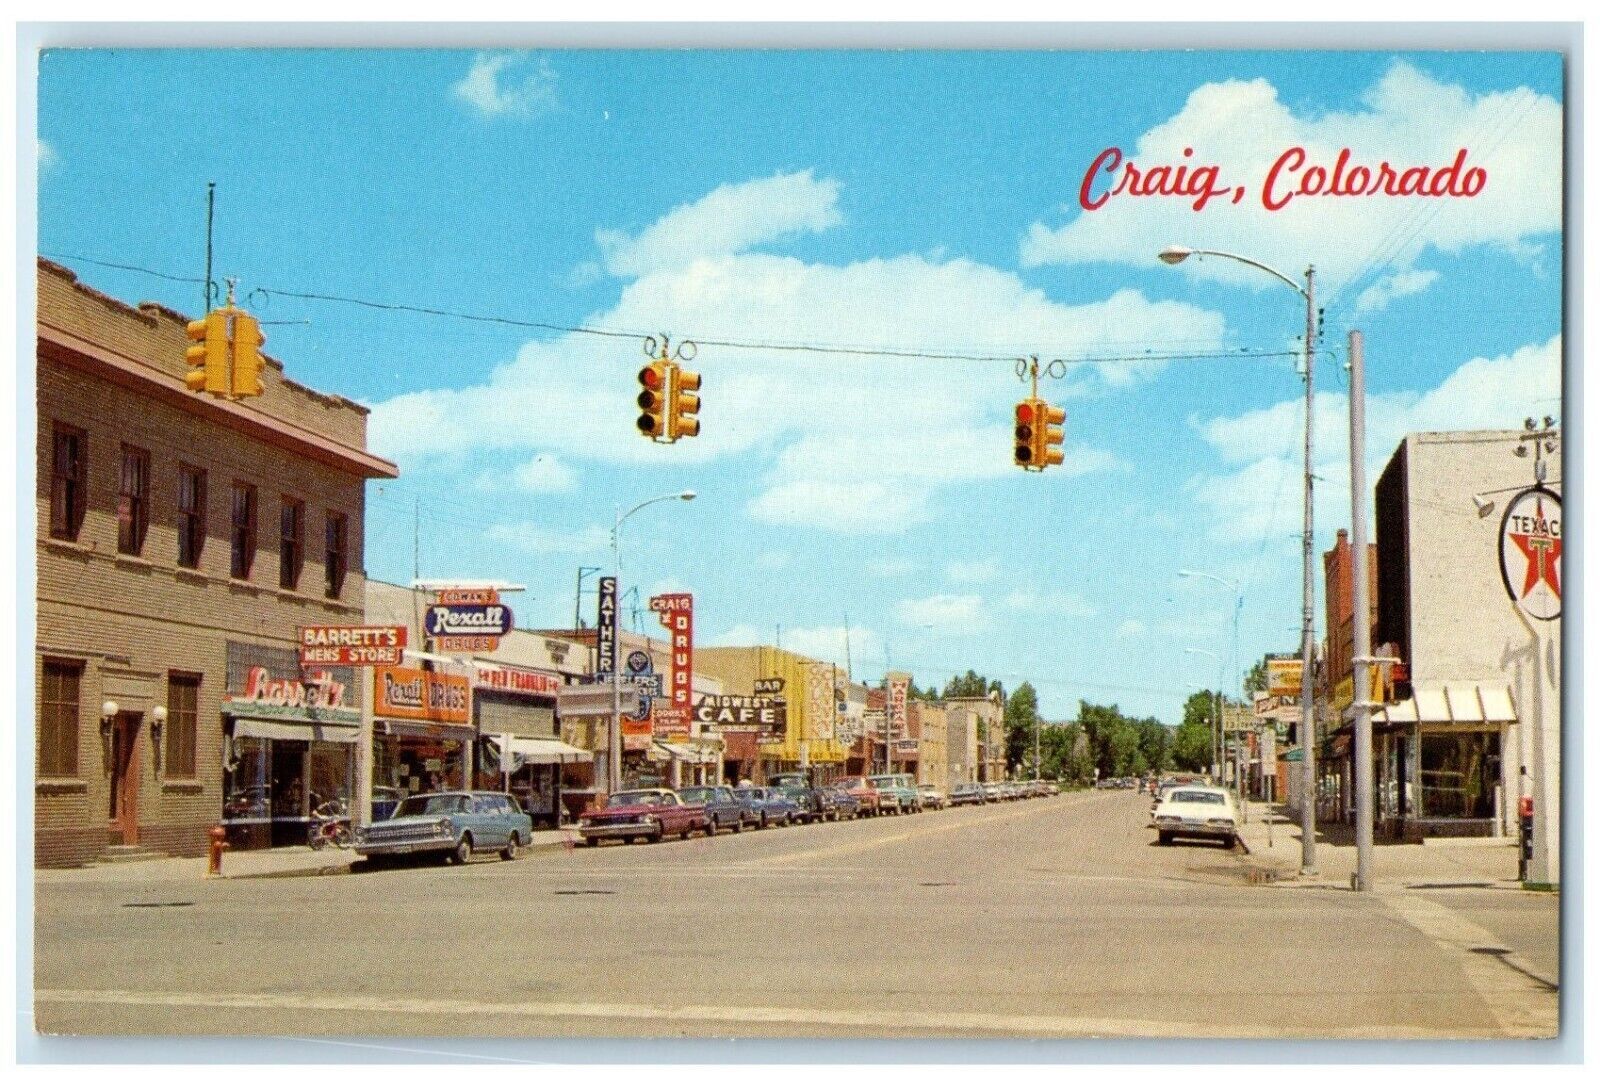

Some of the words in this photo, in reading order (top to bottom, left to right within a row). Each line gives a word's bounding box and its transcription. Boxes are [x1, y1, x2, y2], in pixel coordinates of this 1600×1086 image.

[1512, 515, 1560, 537] TEXAC
[651, 598, 689, 610] CRAIG
[433, 607, 503, 633] Rexall
[600, 579, 615, 672] SATHER
[304, 628, 397, 646] BARRETT'S
[445, 638, 489, 649] DRUGS
[349, 649, 396, 662] STORE
[675, 616, 688, 702] DRUGS
[755, 681, 780, 691] BAR
[430, 681, 465, 709] DRUGS
[703, 695, 769, 708] MIDWEST
[698, 707, 775, 722] CAFE
